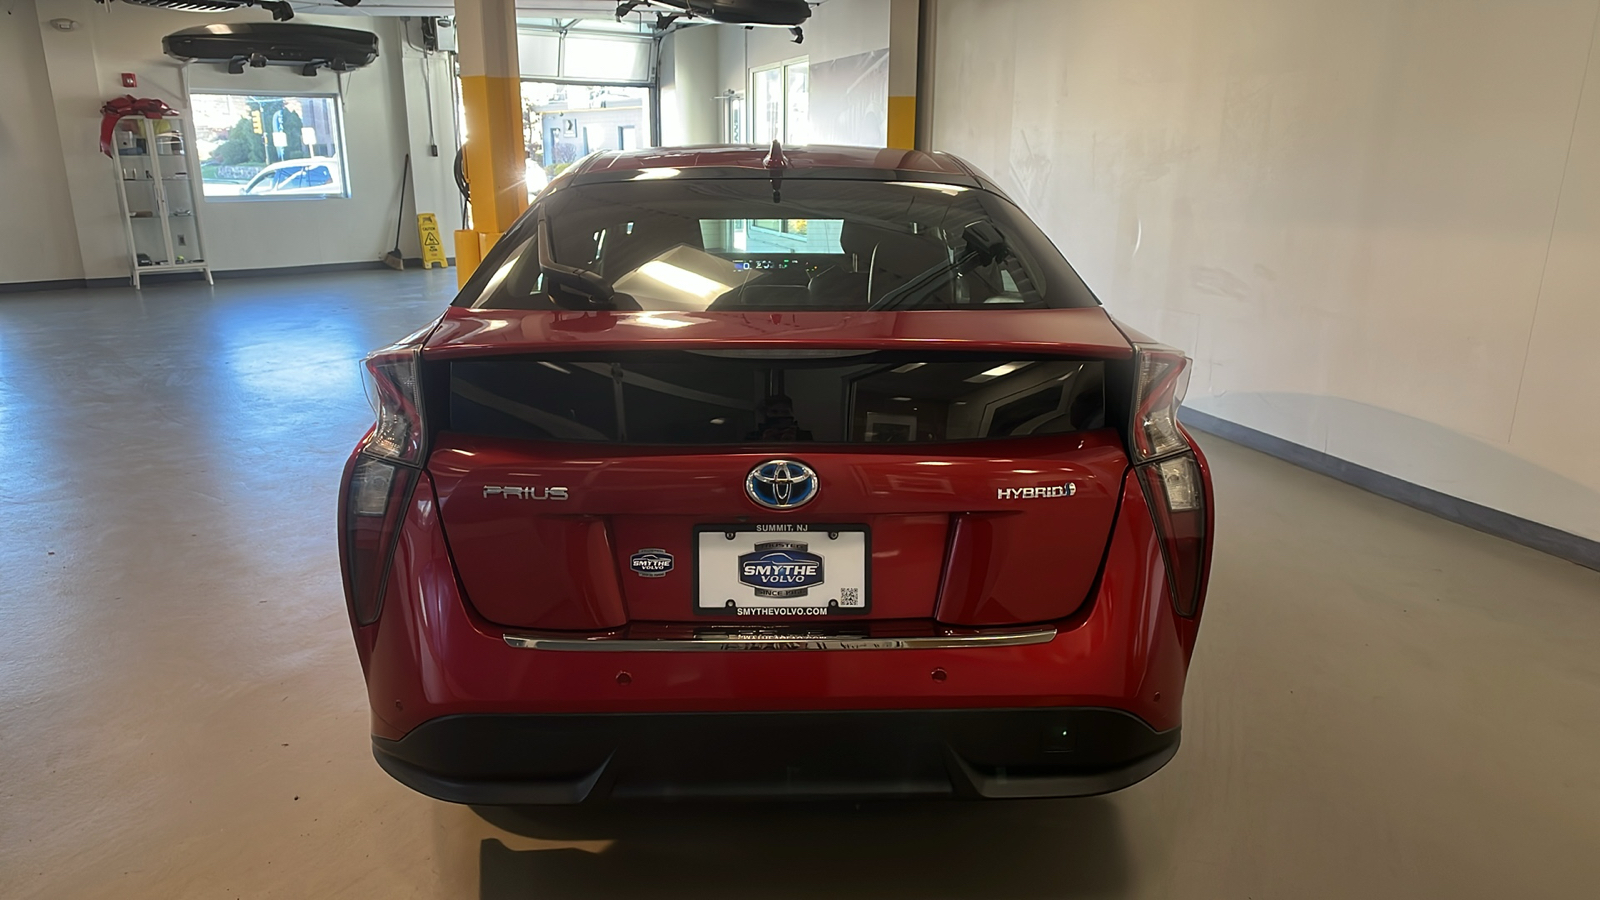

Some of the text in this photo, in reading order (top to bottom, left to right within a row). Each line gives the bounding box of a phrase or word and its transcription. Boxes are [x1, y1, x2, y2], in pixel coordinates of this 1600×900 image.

[482, 484, 569, 501] PRIUS
[997, 486, 1064, 500] HYBRID
[796, 524, 808, 532] NJ
[744, 565, 818, 576] SMYTHE
[761, 575, 805, 583] VOLVO
[737, 607, 828, 616] SMYTHEVOLVO.COM
